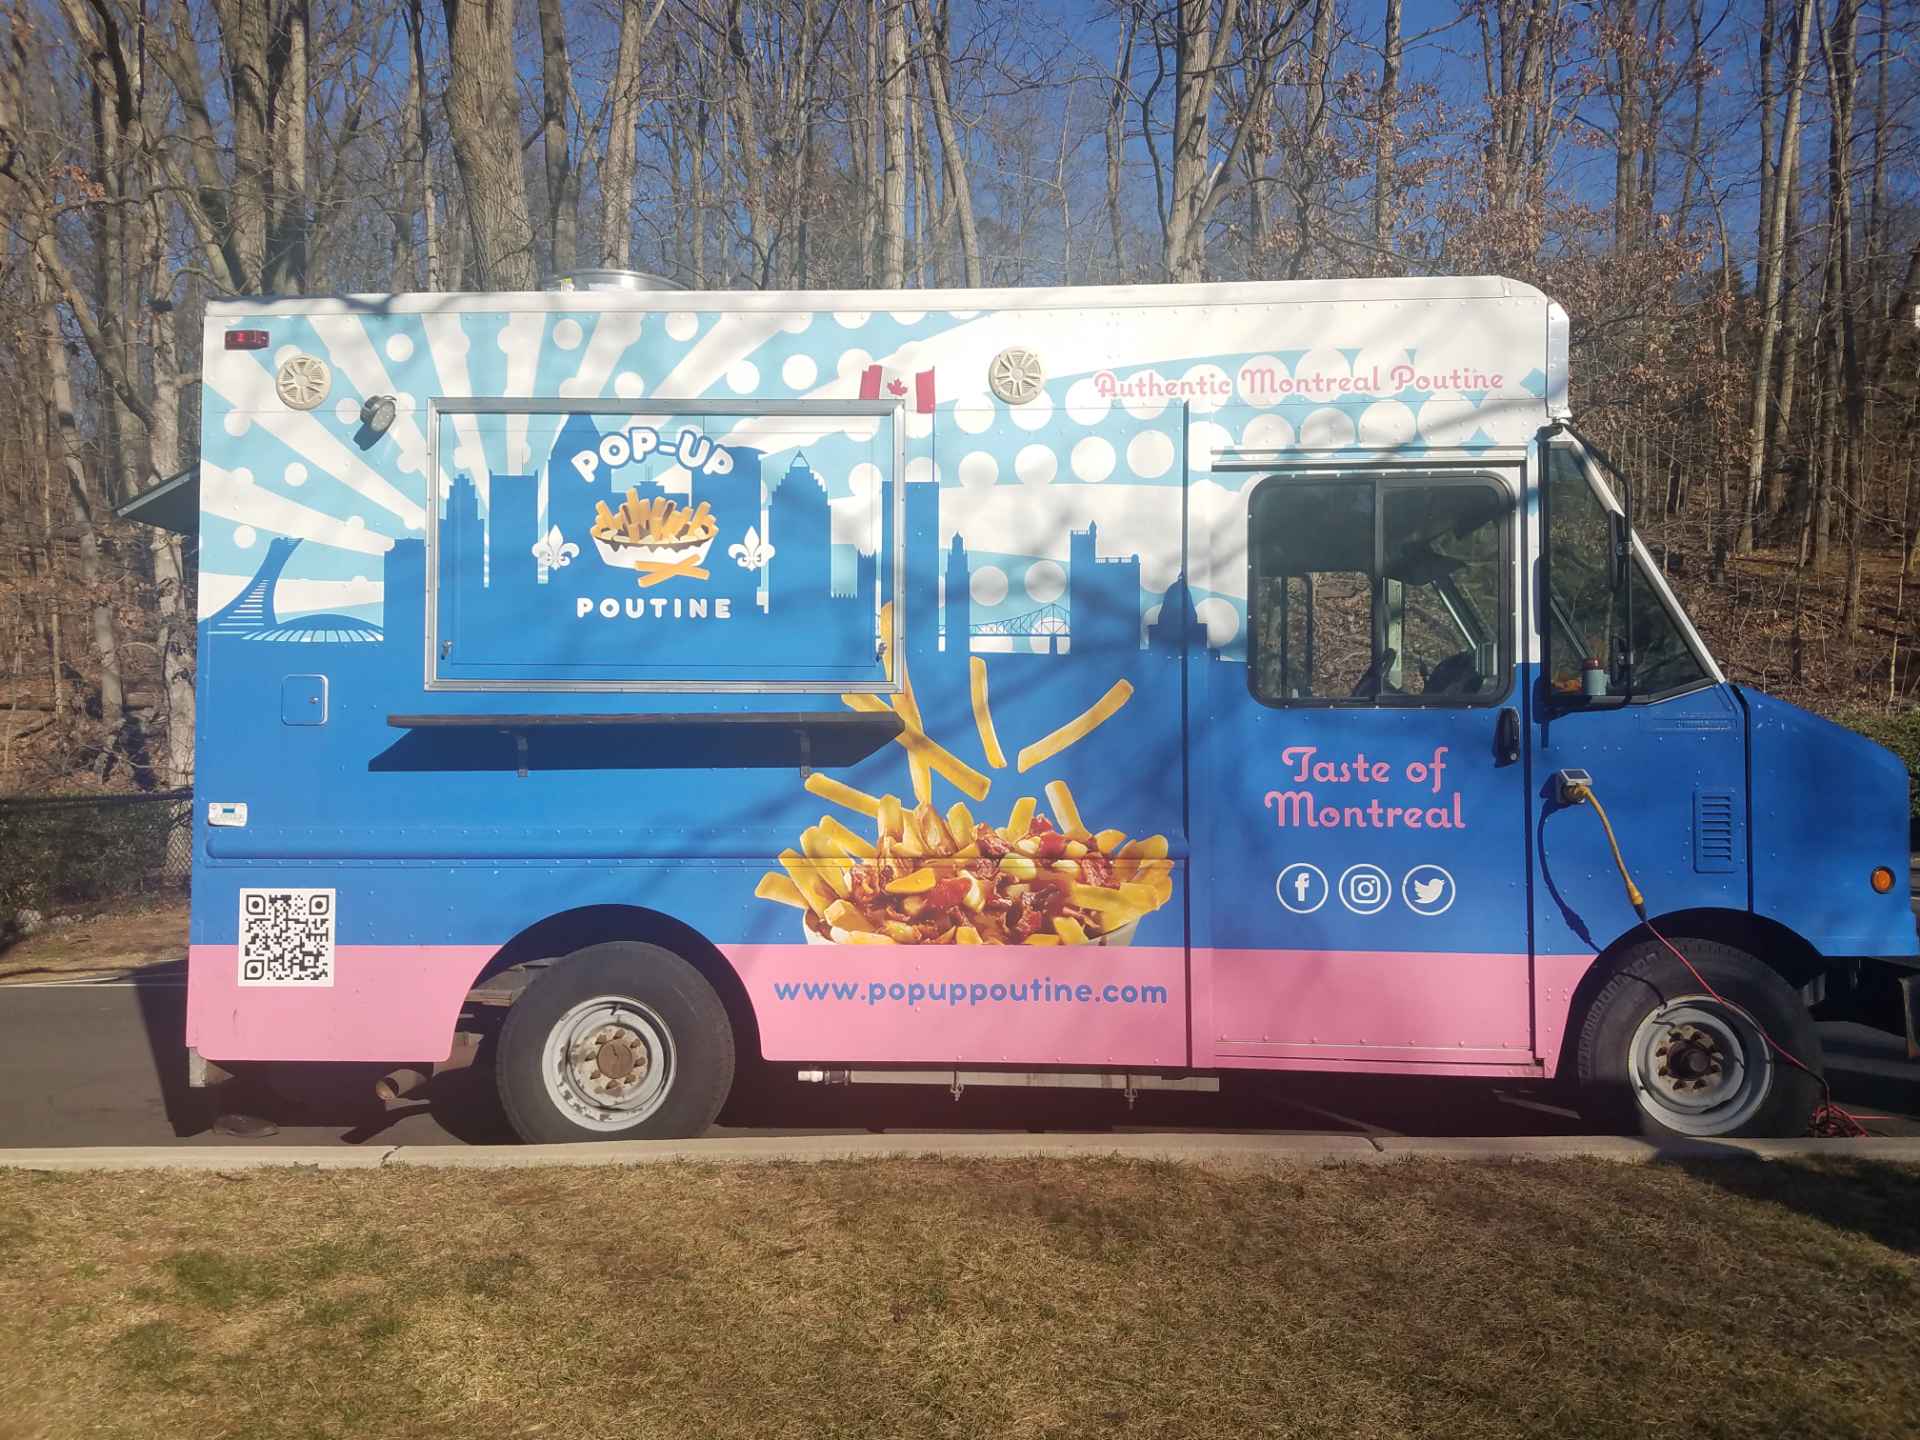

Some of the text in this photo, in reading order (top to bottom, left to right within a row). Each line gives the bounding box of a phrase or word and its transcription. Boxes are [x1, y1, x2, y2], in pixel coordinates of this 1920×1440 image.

[1094, 367, 1504, 397] Authentic Montreal Poutine
[572, 427, 734, 482] POP-UP
[576, 597, 732, 620] POUTINE
[1281, 746, 1448, 793] Taste of
[1264, 791, 1466, 829] Montreal
[773, 977, 1168, 1006] www.popuppoutine.com
